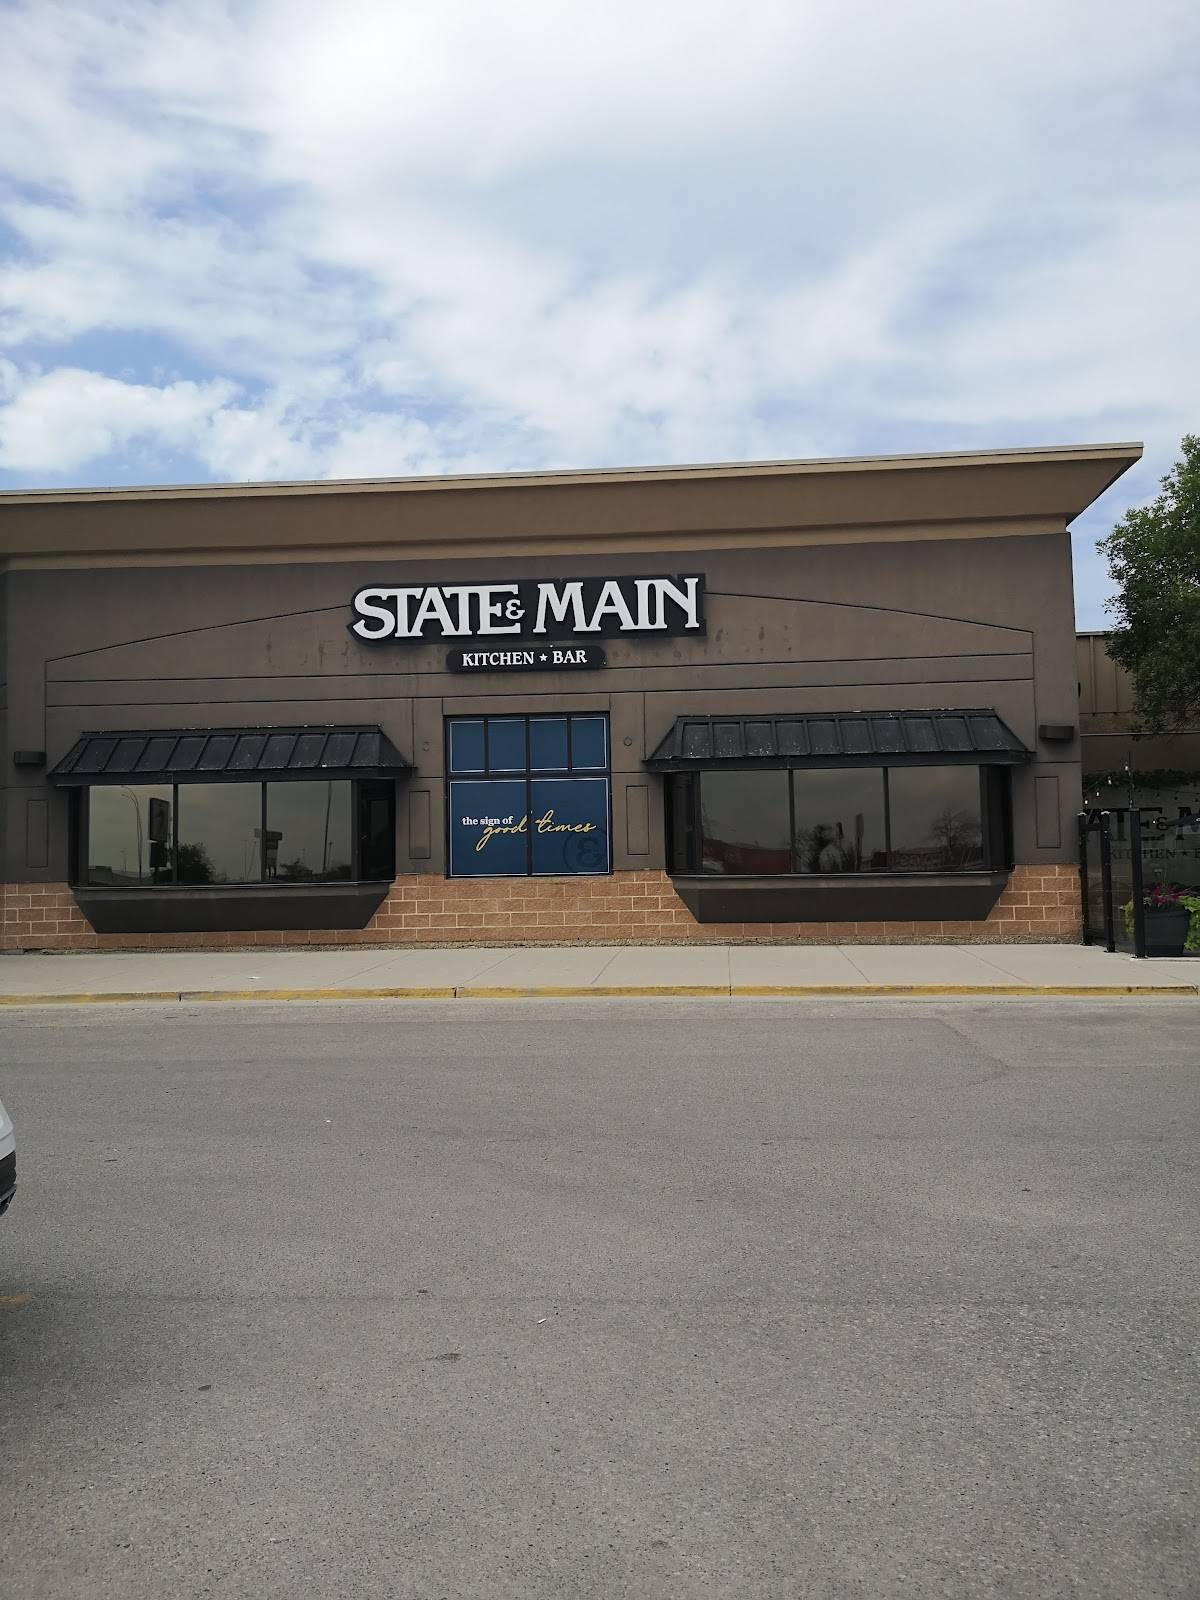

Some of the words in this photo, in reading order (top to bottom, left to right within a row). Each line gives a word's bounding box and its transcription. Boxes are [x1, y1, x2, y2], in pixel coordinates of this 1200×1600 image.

[352, 584, 521, 640] STATE
[533, 577, 700, 634] MAIN
[462, 651, 535, 667] KITCHEN
[552, 649, 588, 664] BAR
[462, 816, 478, 826] the
[480, 816, 501, 827] sign
[502, 815, 514, 825] of
[476, 813, 528, 851] good
[535, 809, 597, 834] times
